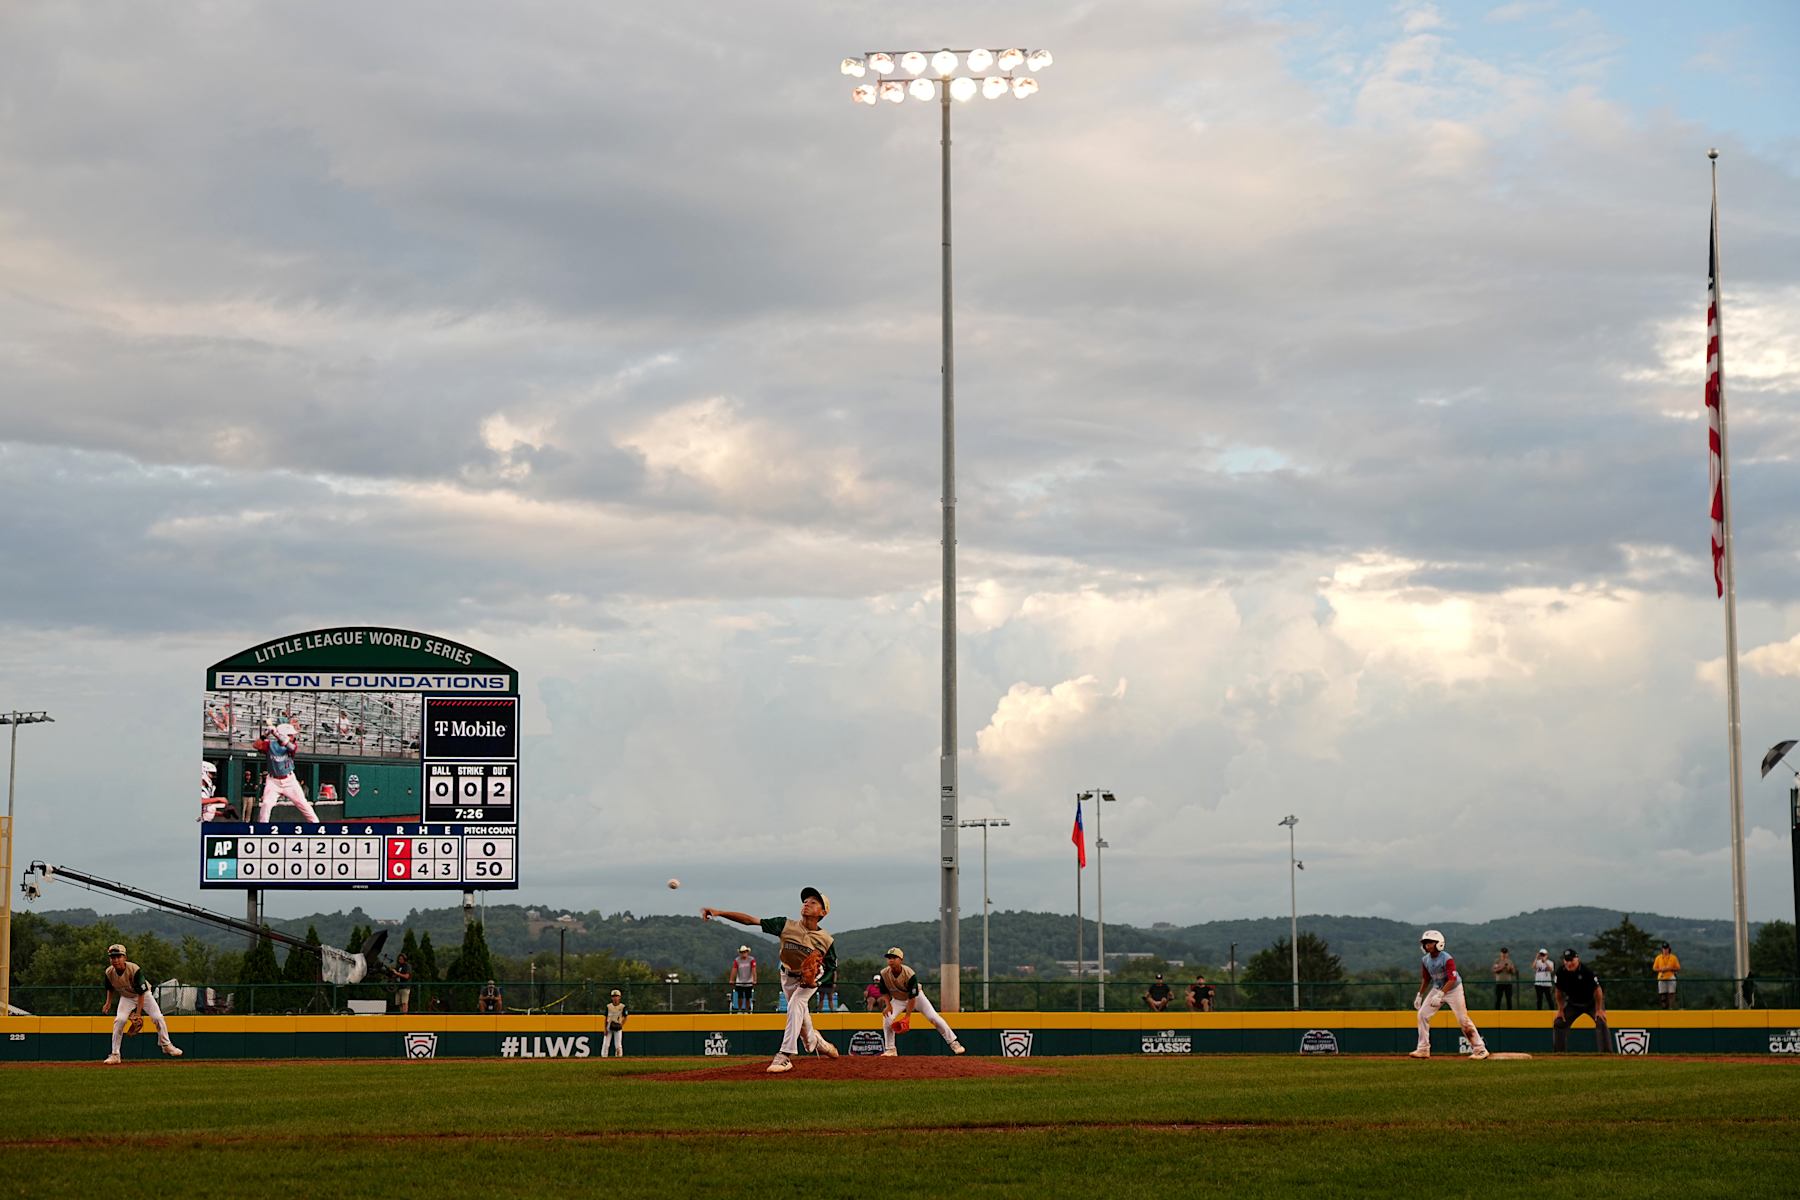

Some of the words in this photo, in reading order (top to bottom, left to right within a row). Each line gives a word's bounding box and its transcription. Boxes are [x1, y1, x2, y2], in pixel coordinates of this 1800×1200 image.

[254, 638, 302, 664] LITTLE
[306, 632, 363, 649] LEAGUE
[369, 632, 422, 650] WORLD
[424, 640, 472, 666] SERIES
[221, 674, 320, 686] EASTON
[331, 676, 504, 688] FOUNDATIONS
[451, 721, 506, 737] Mobile
[432, 766, 452, 776] BALL
[458, 766, 484, 776] STRIKE
[492, 766, 508, 776] OUT
[436, 782, 448, 796] 0
[464, 782, 477, 796] 0
[494, 782, 505, 796] 2
[455, 808, 484, 819] 7:26
[248, 826, 254, 834] 1
[271, 826, 279, 834] 2
[294, 826, 302, 834] 3
[318, 826, 326, 834] 4
[341, 826, 348, 834] 5
[365, 826, 373, 834] 6
[396, 826, 404, 834] R
[419, 826, 428, 834] H
[445, 826, 451, 834] E
[464, 826, 487, 834] PITCH
[488, 826, 516, 834] COUNT
[214, 840, 232, 856] AP
[244, 842, 255, 854] 0
[269, 842, 279, 854] 0
[292, 842, 302, 854] 4
[316, 842, 326, 854] 2
[340, 842, 350, 854] 0
[364, 842, 370, 854] 1
[394, 842, 405, 855] 7
[418, 842, 428, 854] 6
[441, 842, 452, 854] 0
[483, 842, 496, 856] 0
[218, 862, 228, 876] P
[243, 863, 254, 875] 0
[268, 863, 279, 875] 0
[291, 863, 302, 875] 0
[315, 863, 326, 875] 0
[338, 863, 348, 875] 0
[393, 862, 406, 876] 0
[418, 864, 429, 875] 4
[441, 864, 451, 875] 3
[476, 862, 503, 876] 50
[500, 1036, 591, 1058] #LLWS
[705, 1039, 728, 1048] PLAY
[705, 1048, 728, 1056] BALL
